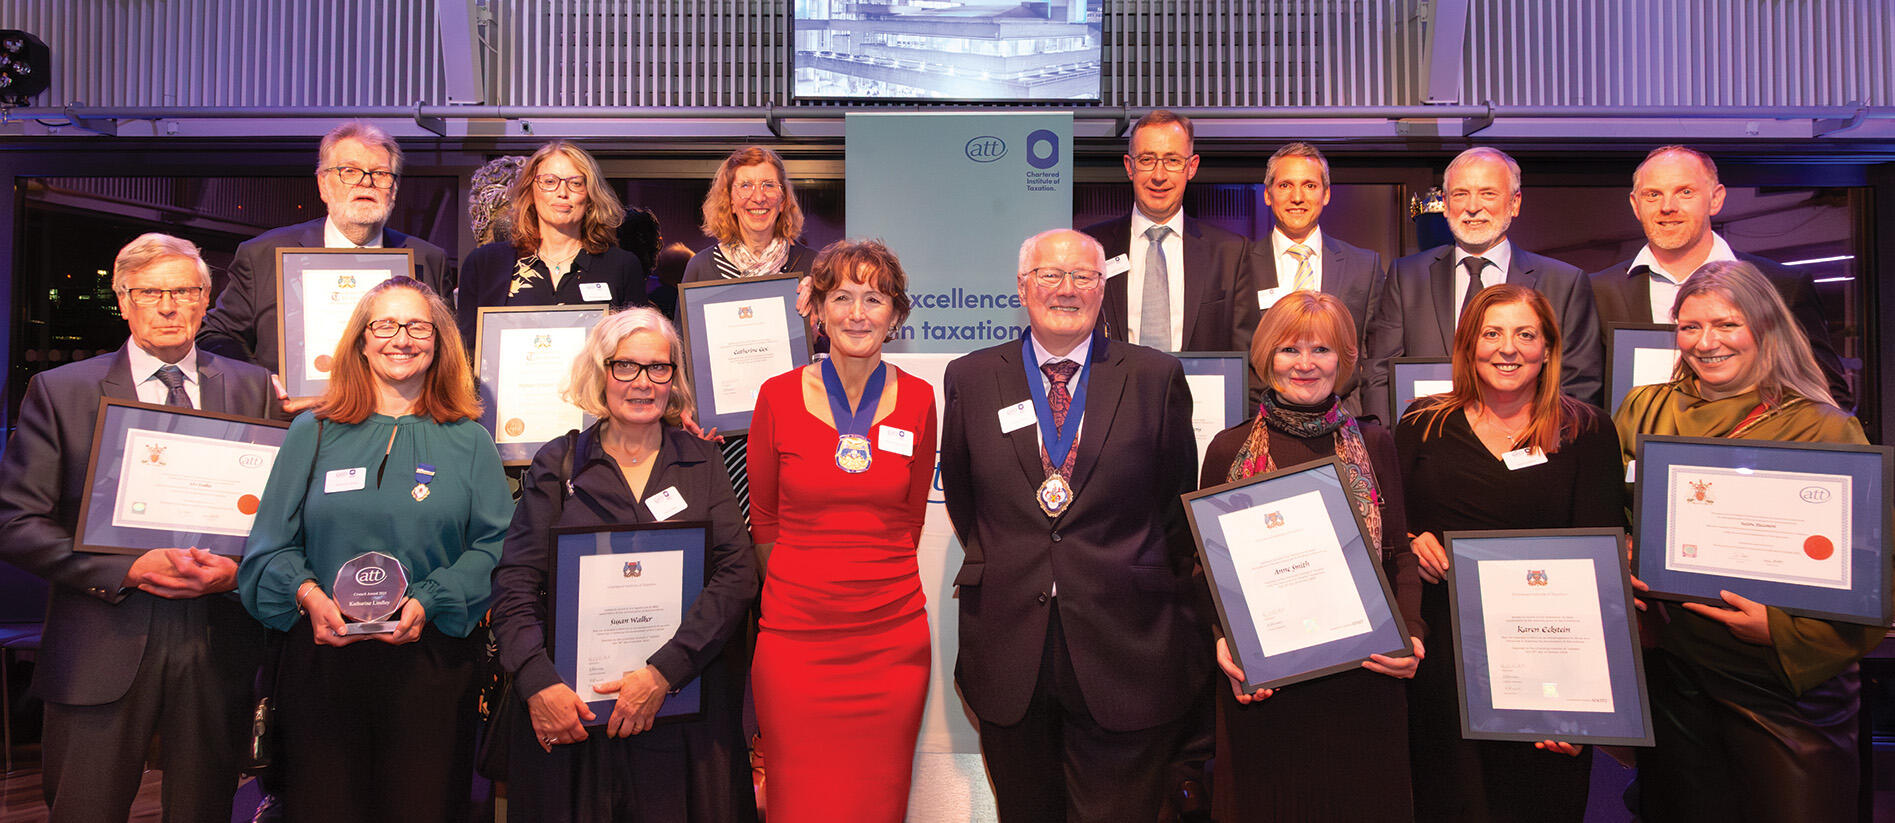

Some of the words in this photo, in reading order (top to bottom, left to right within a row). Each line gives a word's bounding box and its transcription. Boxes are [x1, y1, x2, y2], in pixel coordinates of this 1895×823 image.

[908, 287, 1022, 309] xcellence
[899, 325, 915, 340] n
[922, 319, 1022, 340] taxation
[1291, 560, 1310, 572] Smith
[630, 615, 653, 623] Walker
[1517, 625, 1540, 633] Karen
